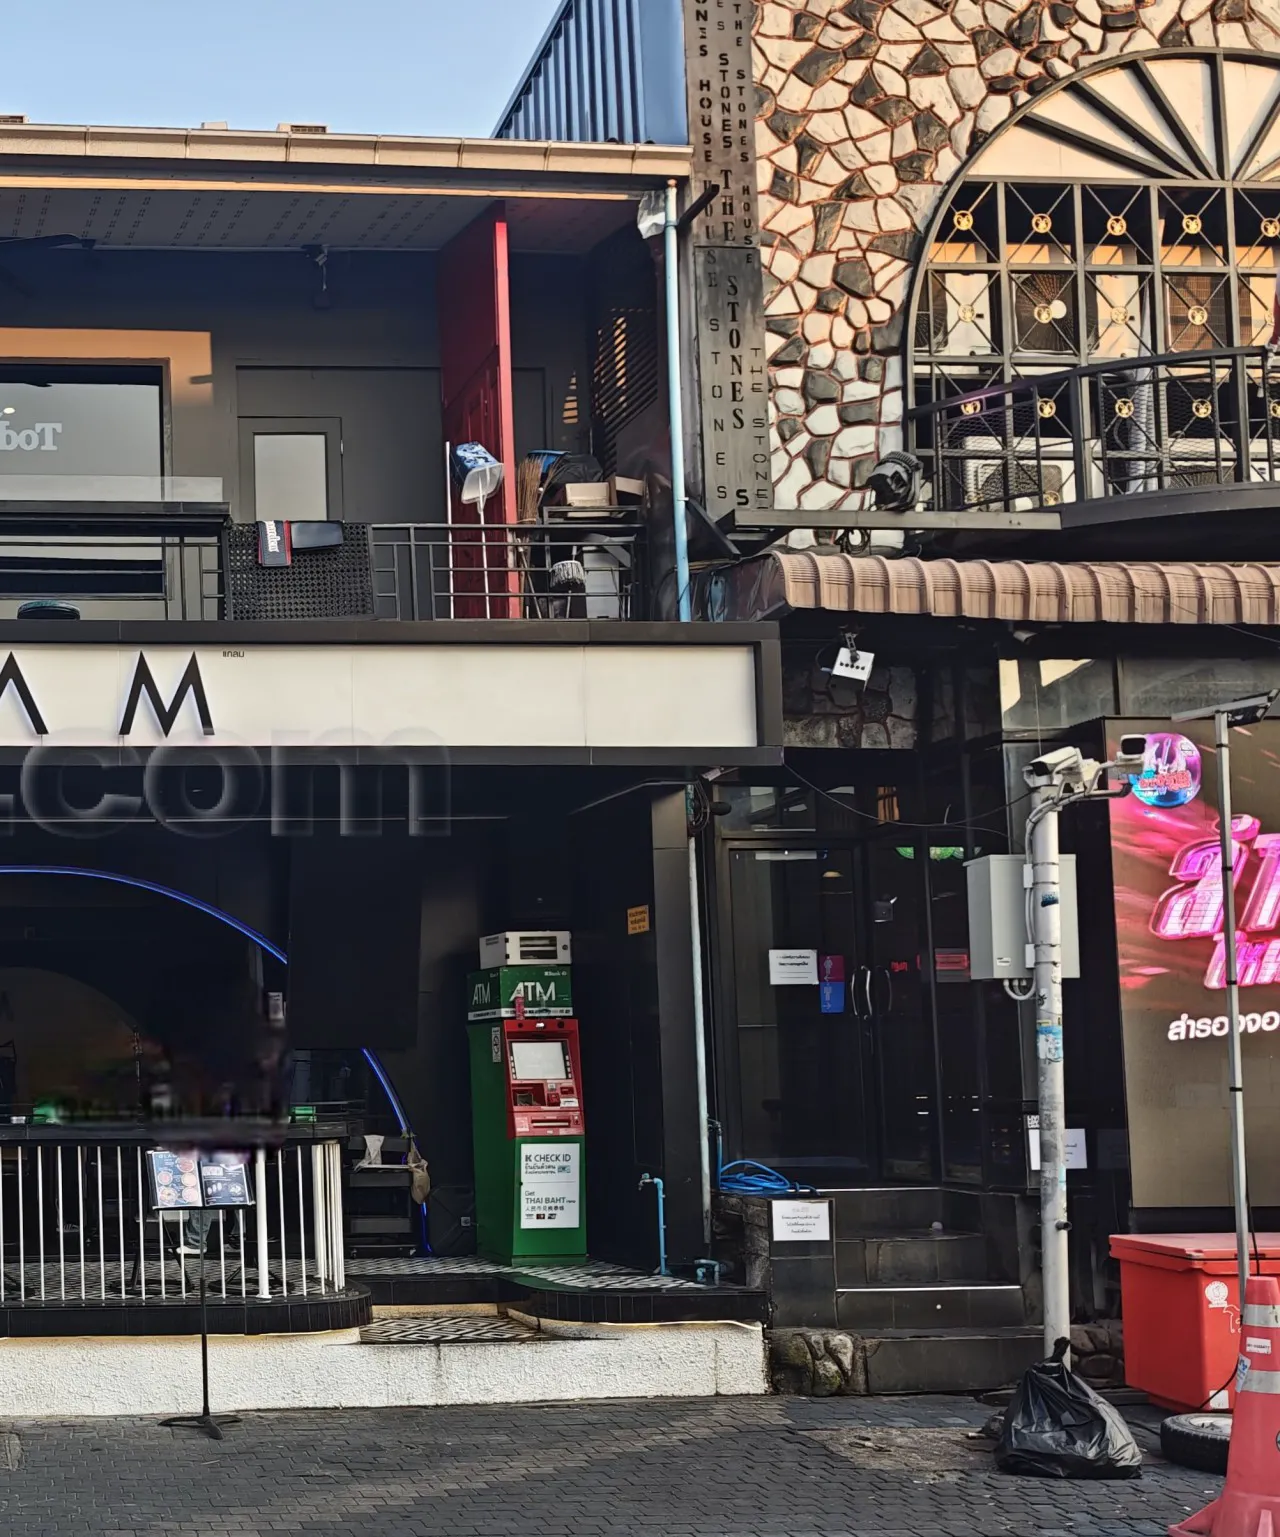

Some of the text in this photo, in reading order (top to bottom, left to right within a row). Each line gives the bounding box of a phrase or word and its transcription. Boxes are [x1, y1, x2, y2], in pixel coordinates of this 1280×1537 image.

[718, 53, 733, 149] STONES
[720, 169, 736, 242] THE
[732, 3, 769, 509] THE STONES HOUSE THE STONE
[699, 79, 713, 163] HOUSE
[708, 318, 728, 500] STONES
[726, 275, 745, 430] STONES
[222, 650, 245, 658] แกลม
[472, 982, 491, 1006] ATM
[509, 981, 556, 1002] ATM
[534, 1154, 561, 1163] CHECK
[563, 1153, 572, 1162] ID
[544, 1196, 566, 1204] BAHT
